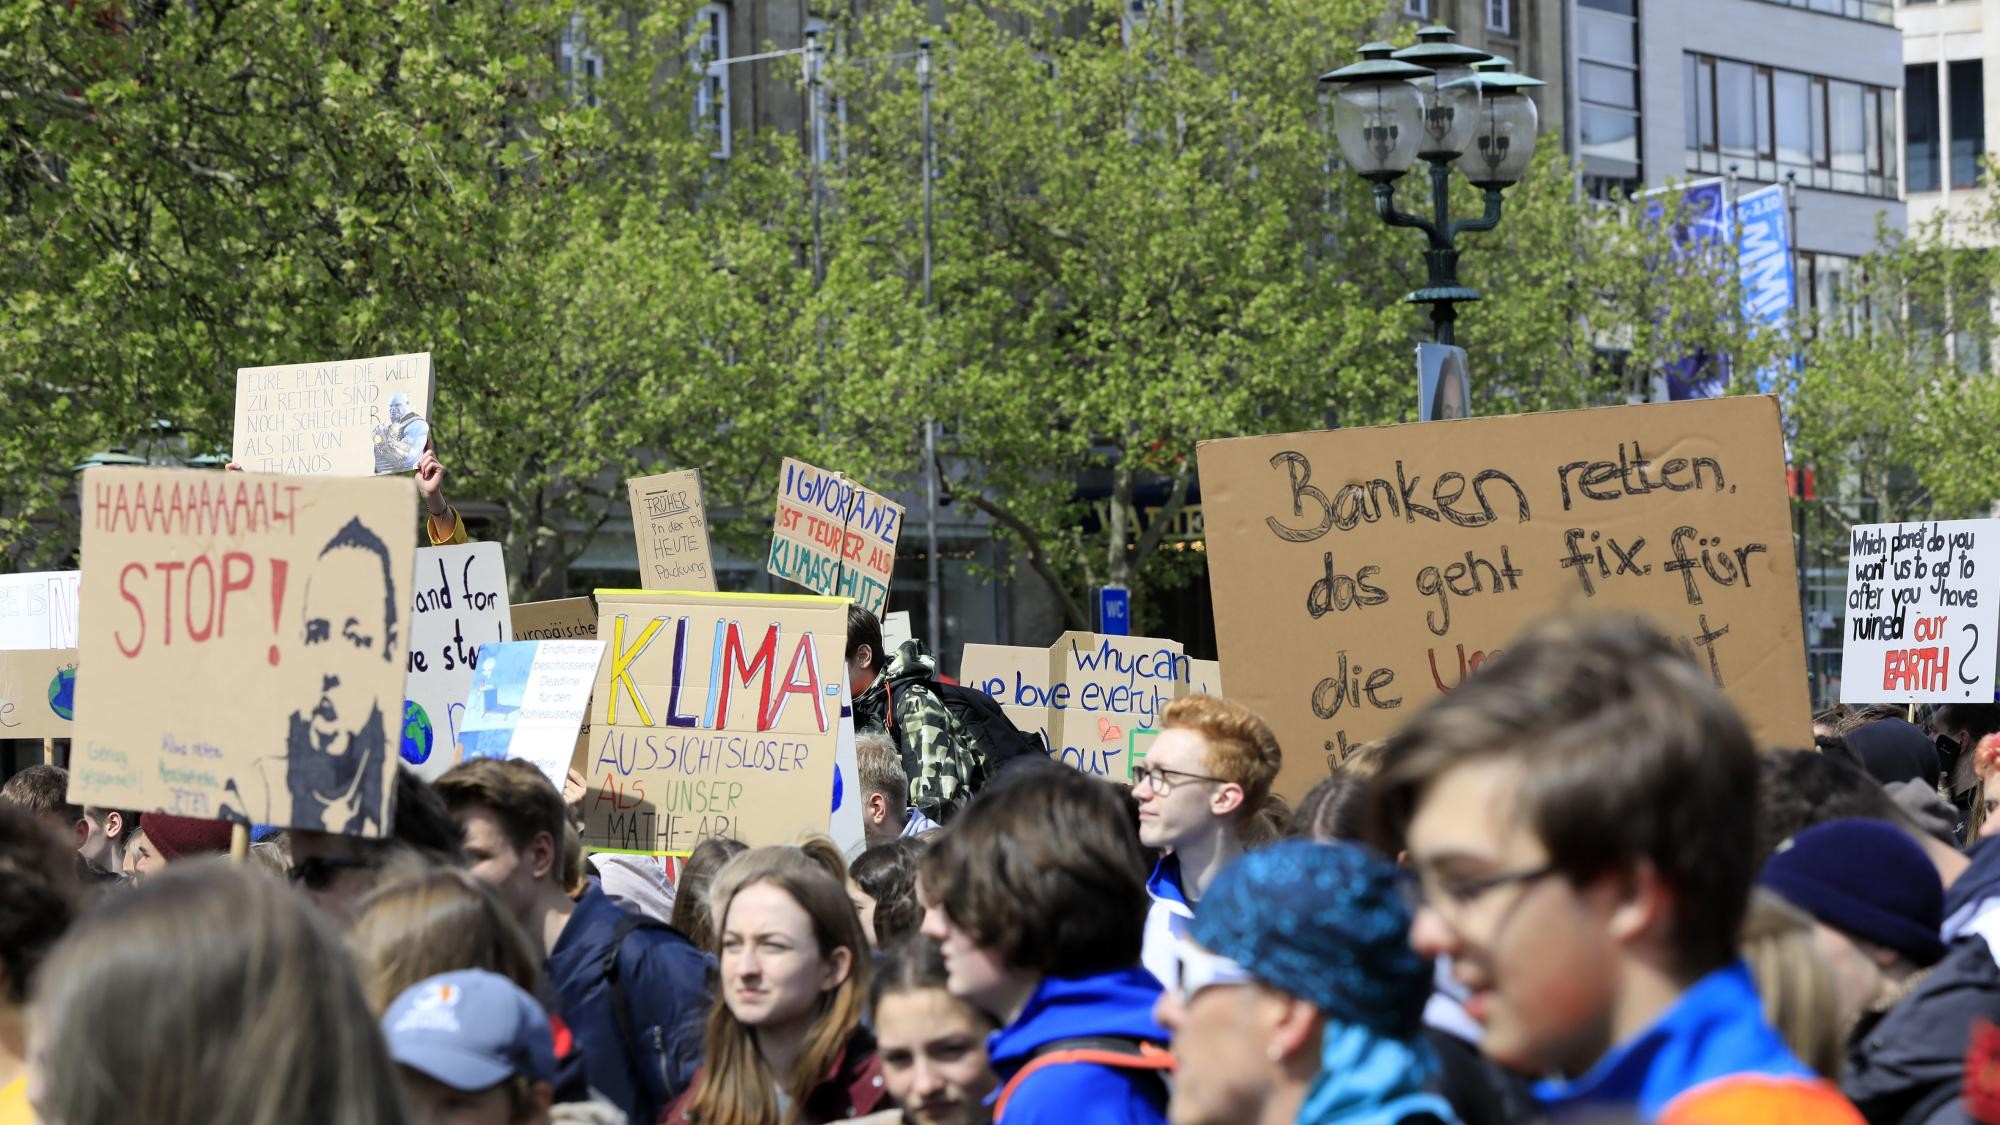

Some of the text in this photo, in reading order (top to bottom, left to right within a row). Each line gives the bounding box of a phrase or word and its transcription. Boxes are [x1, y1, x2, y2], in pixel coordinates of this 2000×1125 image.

[248, 371, 286, 392] EURE
[354, 362, 377, 385] DIE
[385, 357, 422, 381] WELT
[247, 384, 379, 412] ZU RETTEN SIND
[247, 405, 381, 434] NOCH SCHLECHTER
[245, 431, 343, 457] ALS DIE VON
[257, 455, 333, 475] THANOS
[643, 489, 690, 517] FRÜHER
[785, 464, 898, 545] IGNORANZ
[1265, 449, 1531, 543] Banken
[651, 522, 665, 535] in
[668, 520, 684, 534] der
[806, 515, 865, 563] TEURER
[867, 546, 892, 575] ALS
[1852, 528, 1887, 557] Which
[1926, 522, 1945, 552] do
[1949, 531, 1975, 563] you
[653, 535, 700, 559] HEUTE
[462, 554, 498, 611] for
[654, 561, 707, 580] Packung
[769, 535, 888, 614] KLIMASCHUTZ
[1306, 551, 1390, 619] das
[1416, 544, 1524, 636] geht
[1663, 525, 1768, 605] für
[1856, 549, 1975, 594] want us to go to
[27, 583, 48, 617] IS
[48, 576, 80, 650] N
[114, 551, 288, 667] STOP!
[1105, 599, 1124, 618] WC
[1849, 579, 1979, 616] after you have
[1852, 605, 1948, 642] ruined our
[533, 660, 597, 672] beschlossene
[541, 643, 599, 655] Endlich eine
[539, 675, 581, 687] Deadline
[606, 613, 841, 736] KLIMA-
[1311, 649, 1403, 720] die
[1882, 646, 1950, 692] EARTH
[553, 691, 572, 703] den
[1014, 670, 1071, 710] love
[519, 709, 583, 722] Kohleausstieg
[595, 729, 809, 776] AUSSICHTSLOSER
[594, 772, 743, 813] ALS UNSER
[607, 811, 738, 850] MATHE-ABI
